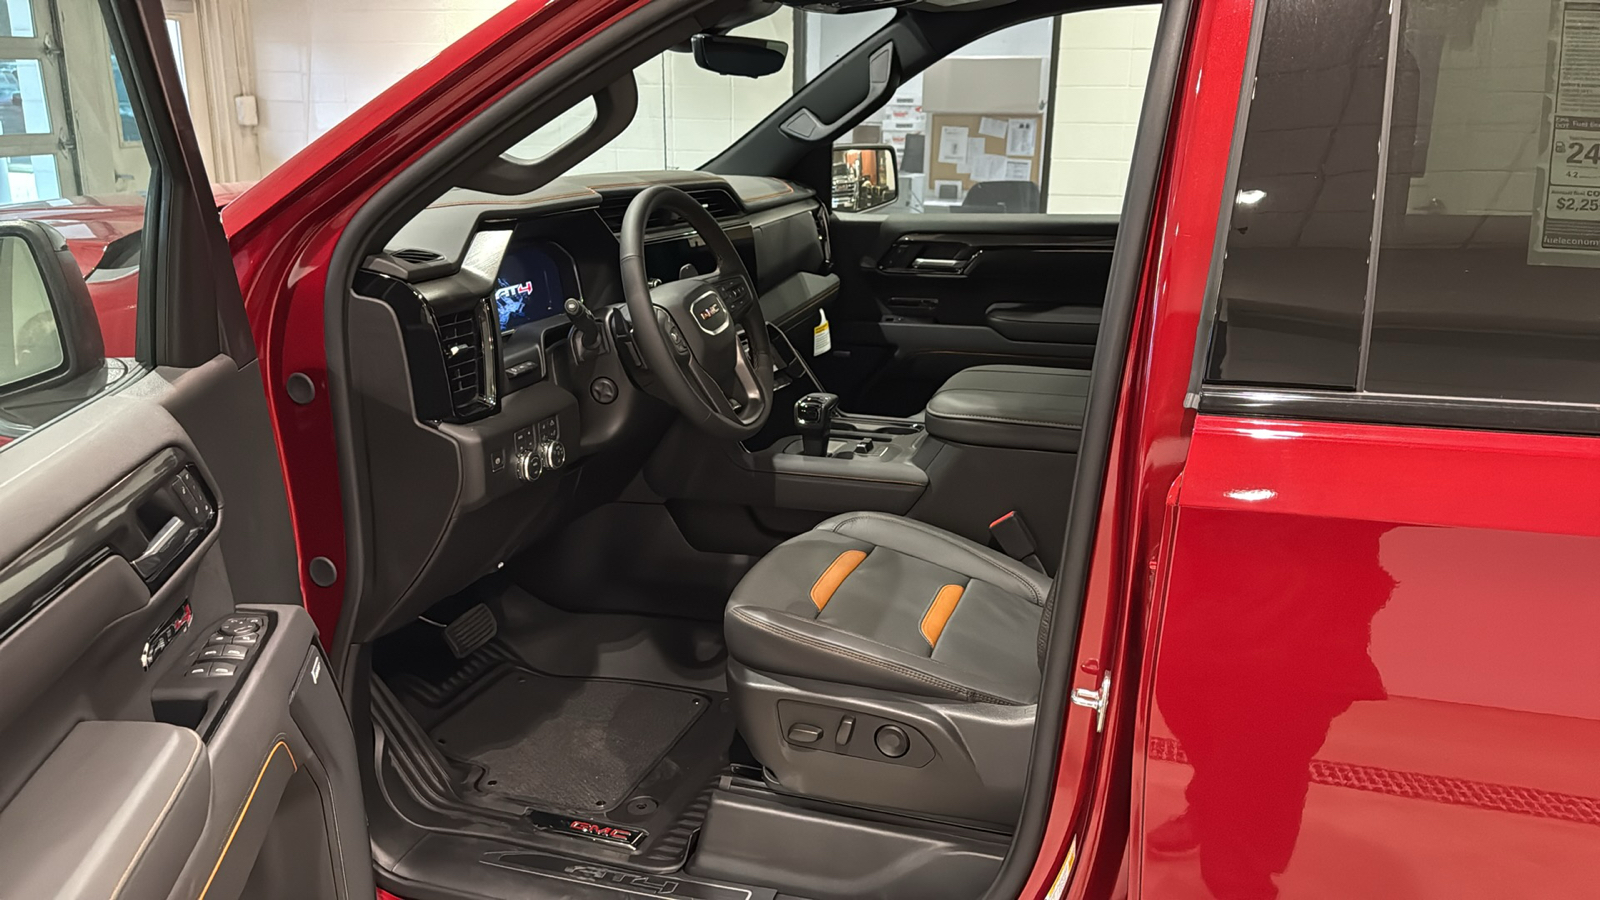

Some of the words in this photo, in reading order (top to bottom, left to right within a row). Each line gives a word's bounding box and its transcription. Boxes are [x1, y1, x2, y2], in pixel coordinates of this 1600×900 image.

[1566, 142, 1600, 165] 24
[1556, 197, 1600, 212] $2,25
[1543, 235, 1600, 246] fueleconom
[570, 820, 632, 841] GMC
